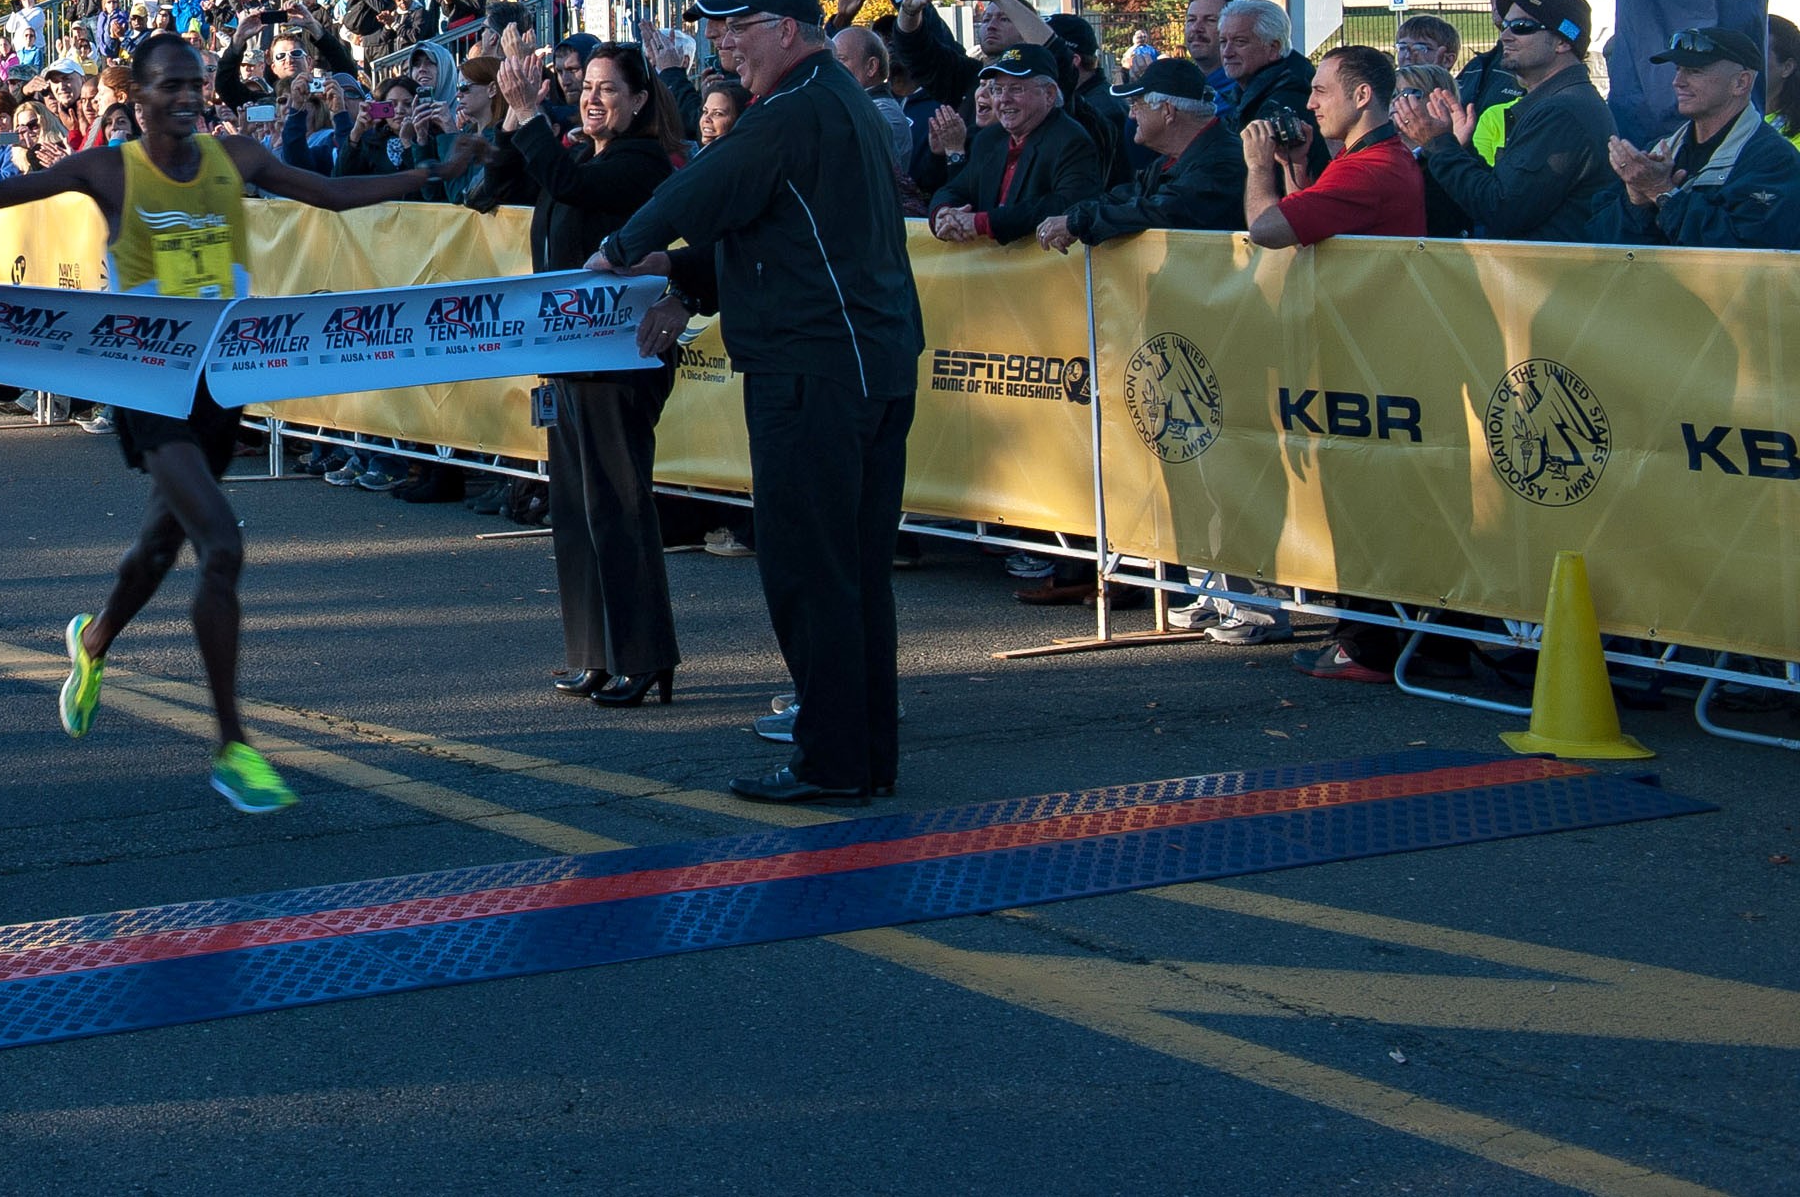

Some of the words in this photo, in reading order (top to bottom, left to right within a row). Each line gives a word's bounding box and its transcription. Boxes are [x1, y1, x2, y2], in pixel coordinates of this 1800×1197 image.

[322, 301, 407, 335] ARMY
[424, 293, 505, 327] ARMY
[89, 314, 193, 343] ARMY
[217, 312, 305, 345] ARMY
[325, 327, 414, 350] TEN-MILER
[429, 320, 525, 342] TEN-MILER
[101, 350, 129, 361] AUSA
[141, 355, 166, 367] KBR
[218, 335, 310, 358] TEN-MILER
[341, 353, 365, 363] AUSA
[374, 350, 396, 361] KBR
[445, 345, 469, 355] AUSA
[478, 342, 501, 352] KBR
[1146, 336, 1168, 355] THE
[1172, 336, 1206, 370] UNITED
[232, 361, 257, 372] AUSA
[267, 358, 289, 369] KBR
[1131, 352, 1148, 372] OF
[1511, 363, 1538, 384] THE
[681, 369, 687, 380] A
[688, 369, 702, 381] Dice
[703, 371, 726, 383] Service
[932, 376, 964, 391] HOME
[967, 379, 982, 393] OF
[984, 380, 1004, 395] THE
[1006, 382, 1063, 400] REDSKINS
[1544, 362, 1590, 401] UNITED
[1205, 374, 1220, 427] STATES
[1498, 380, 1514, 403] OF
[1126, 373, 1170, 458] ASSOCIATION
[1279, 387, 1423, 443] KBR
[1181, 427, 1213, 459] ARMY
[1589, 405, 1609, 466] STATES
[1489, 405, 1548, 500] ASSOCIATION
[1564, 466, 1596, 502] ARMY
